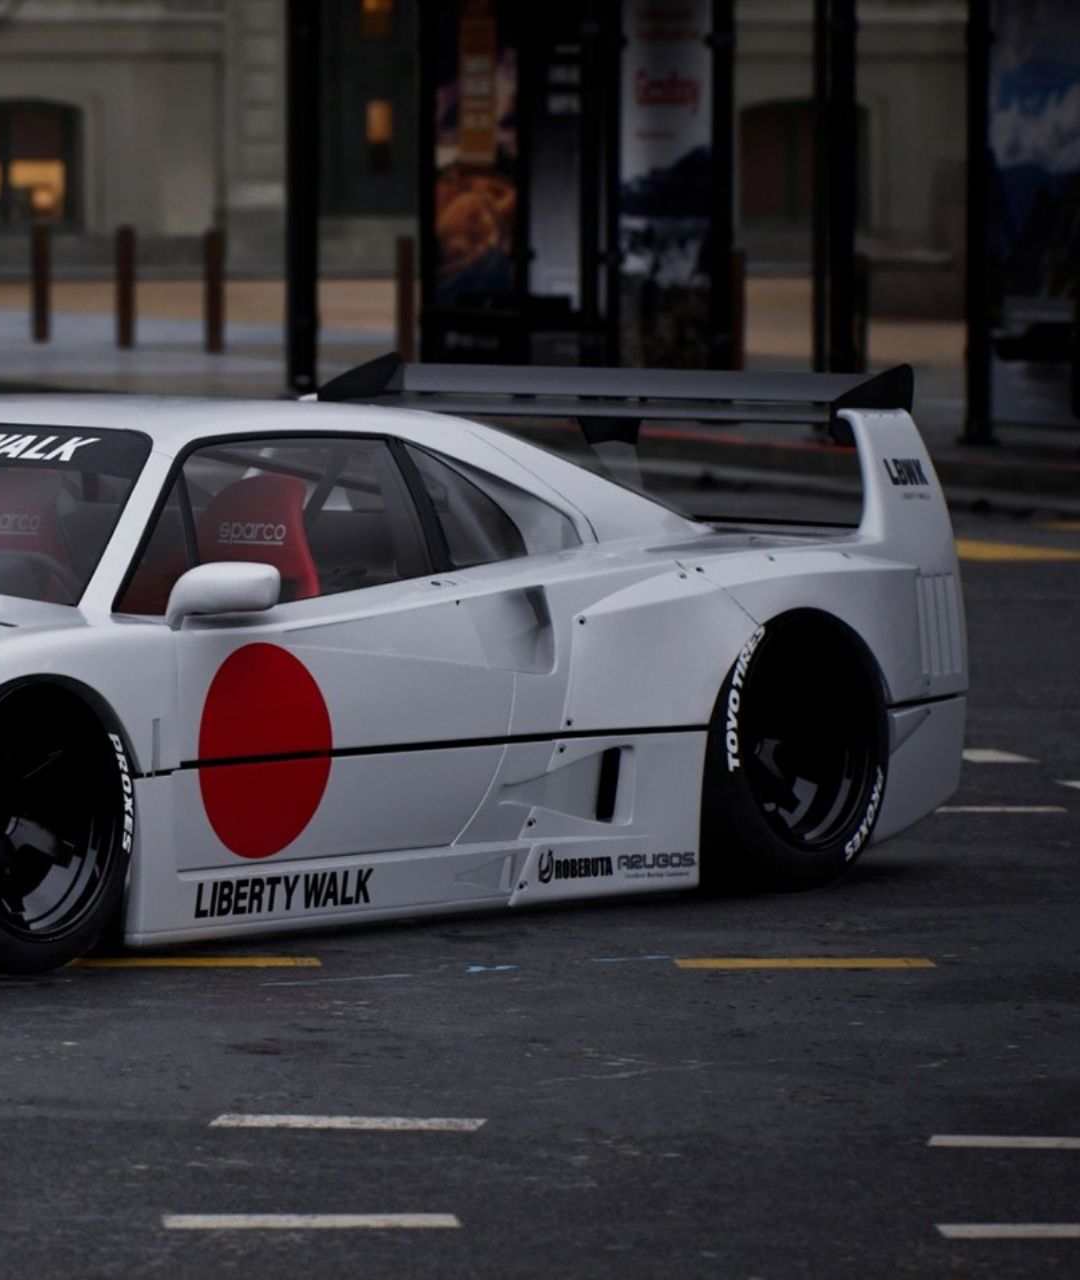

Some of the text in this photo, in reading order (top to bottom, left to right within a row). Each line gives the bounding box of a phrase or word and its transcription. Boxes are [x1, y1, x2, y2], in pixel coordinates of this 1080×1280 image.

[883, 458, 929, 486] LBWK
[218, 519, 286, 545] sparco
[108, 732, 135, 853] PROXES
[844, 765, 883, 862] PROXES
[554, 856, 613, 880] ROBERUTA
[194, 868, 375, 919] LIBERTY WALK
